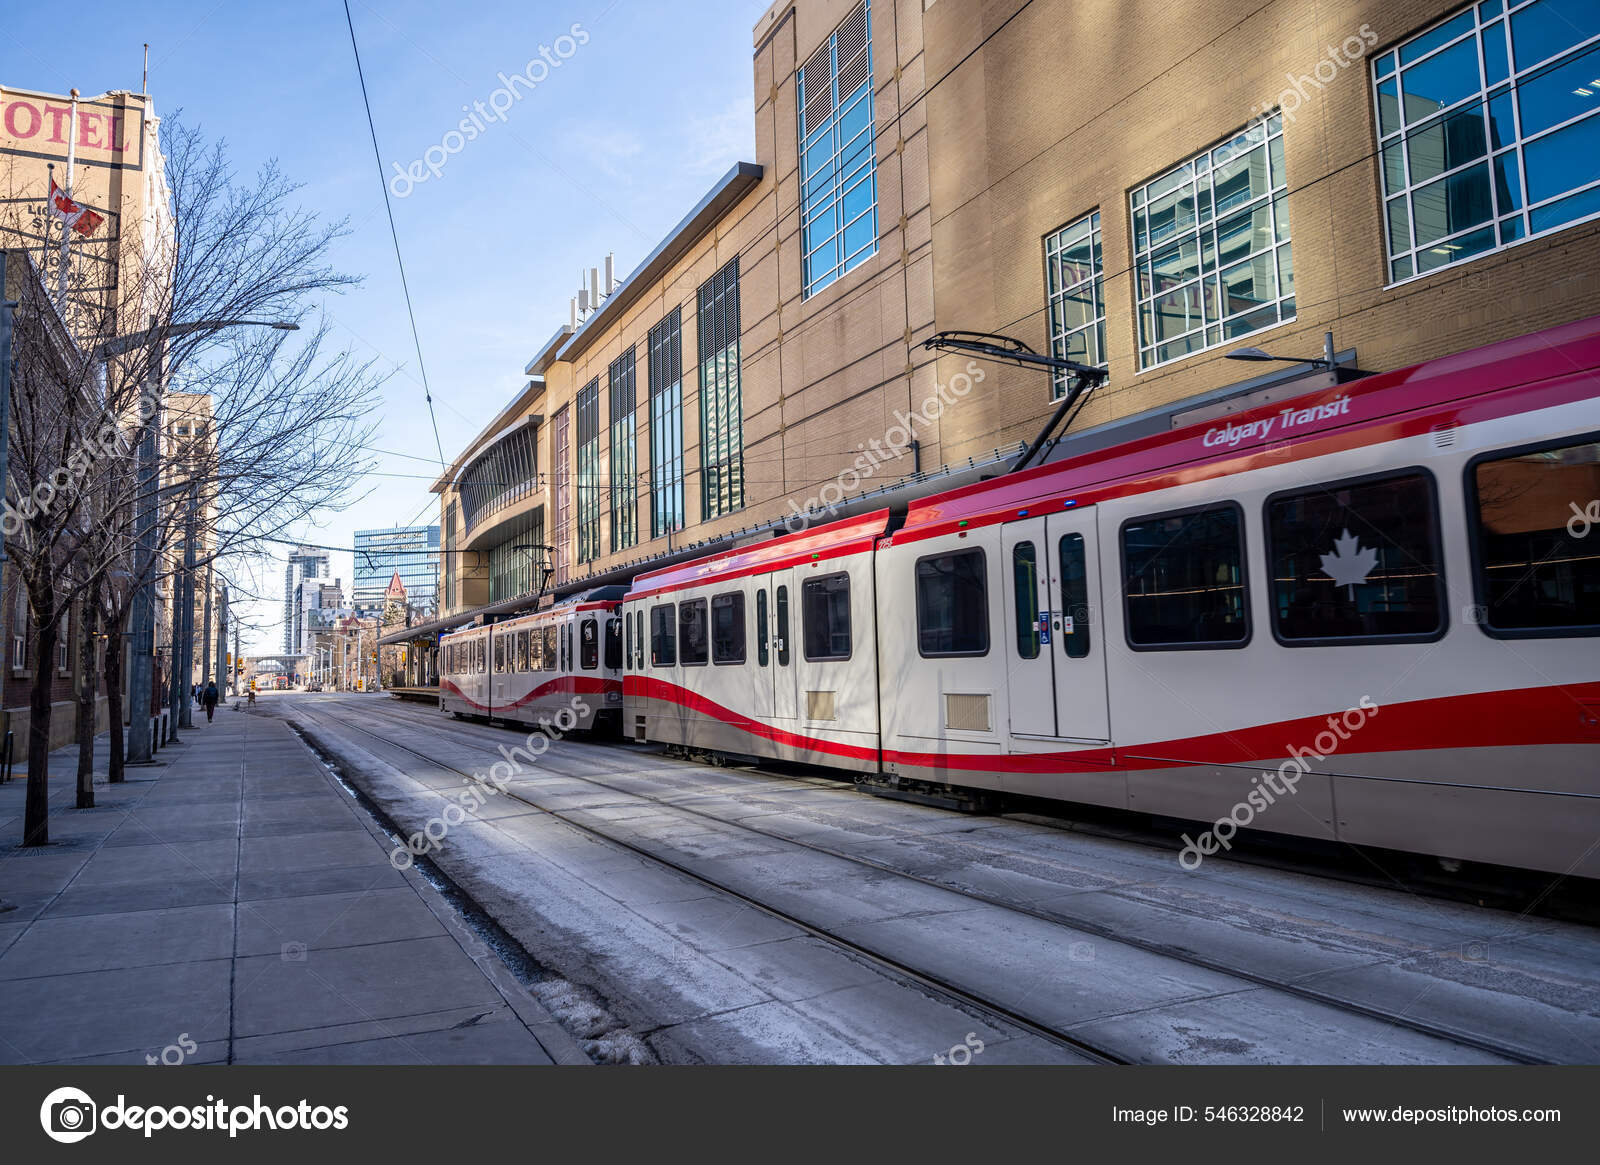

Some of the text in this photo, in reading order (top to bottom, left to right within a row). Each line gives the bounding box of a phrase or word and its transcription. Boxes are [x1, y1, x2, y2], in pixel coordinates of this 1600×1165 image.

[0, 100, 130, 152] OTEL
[1202, 394, 1353, 447] Calgary Transit
